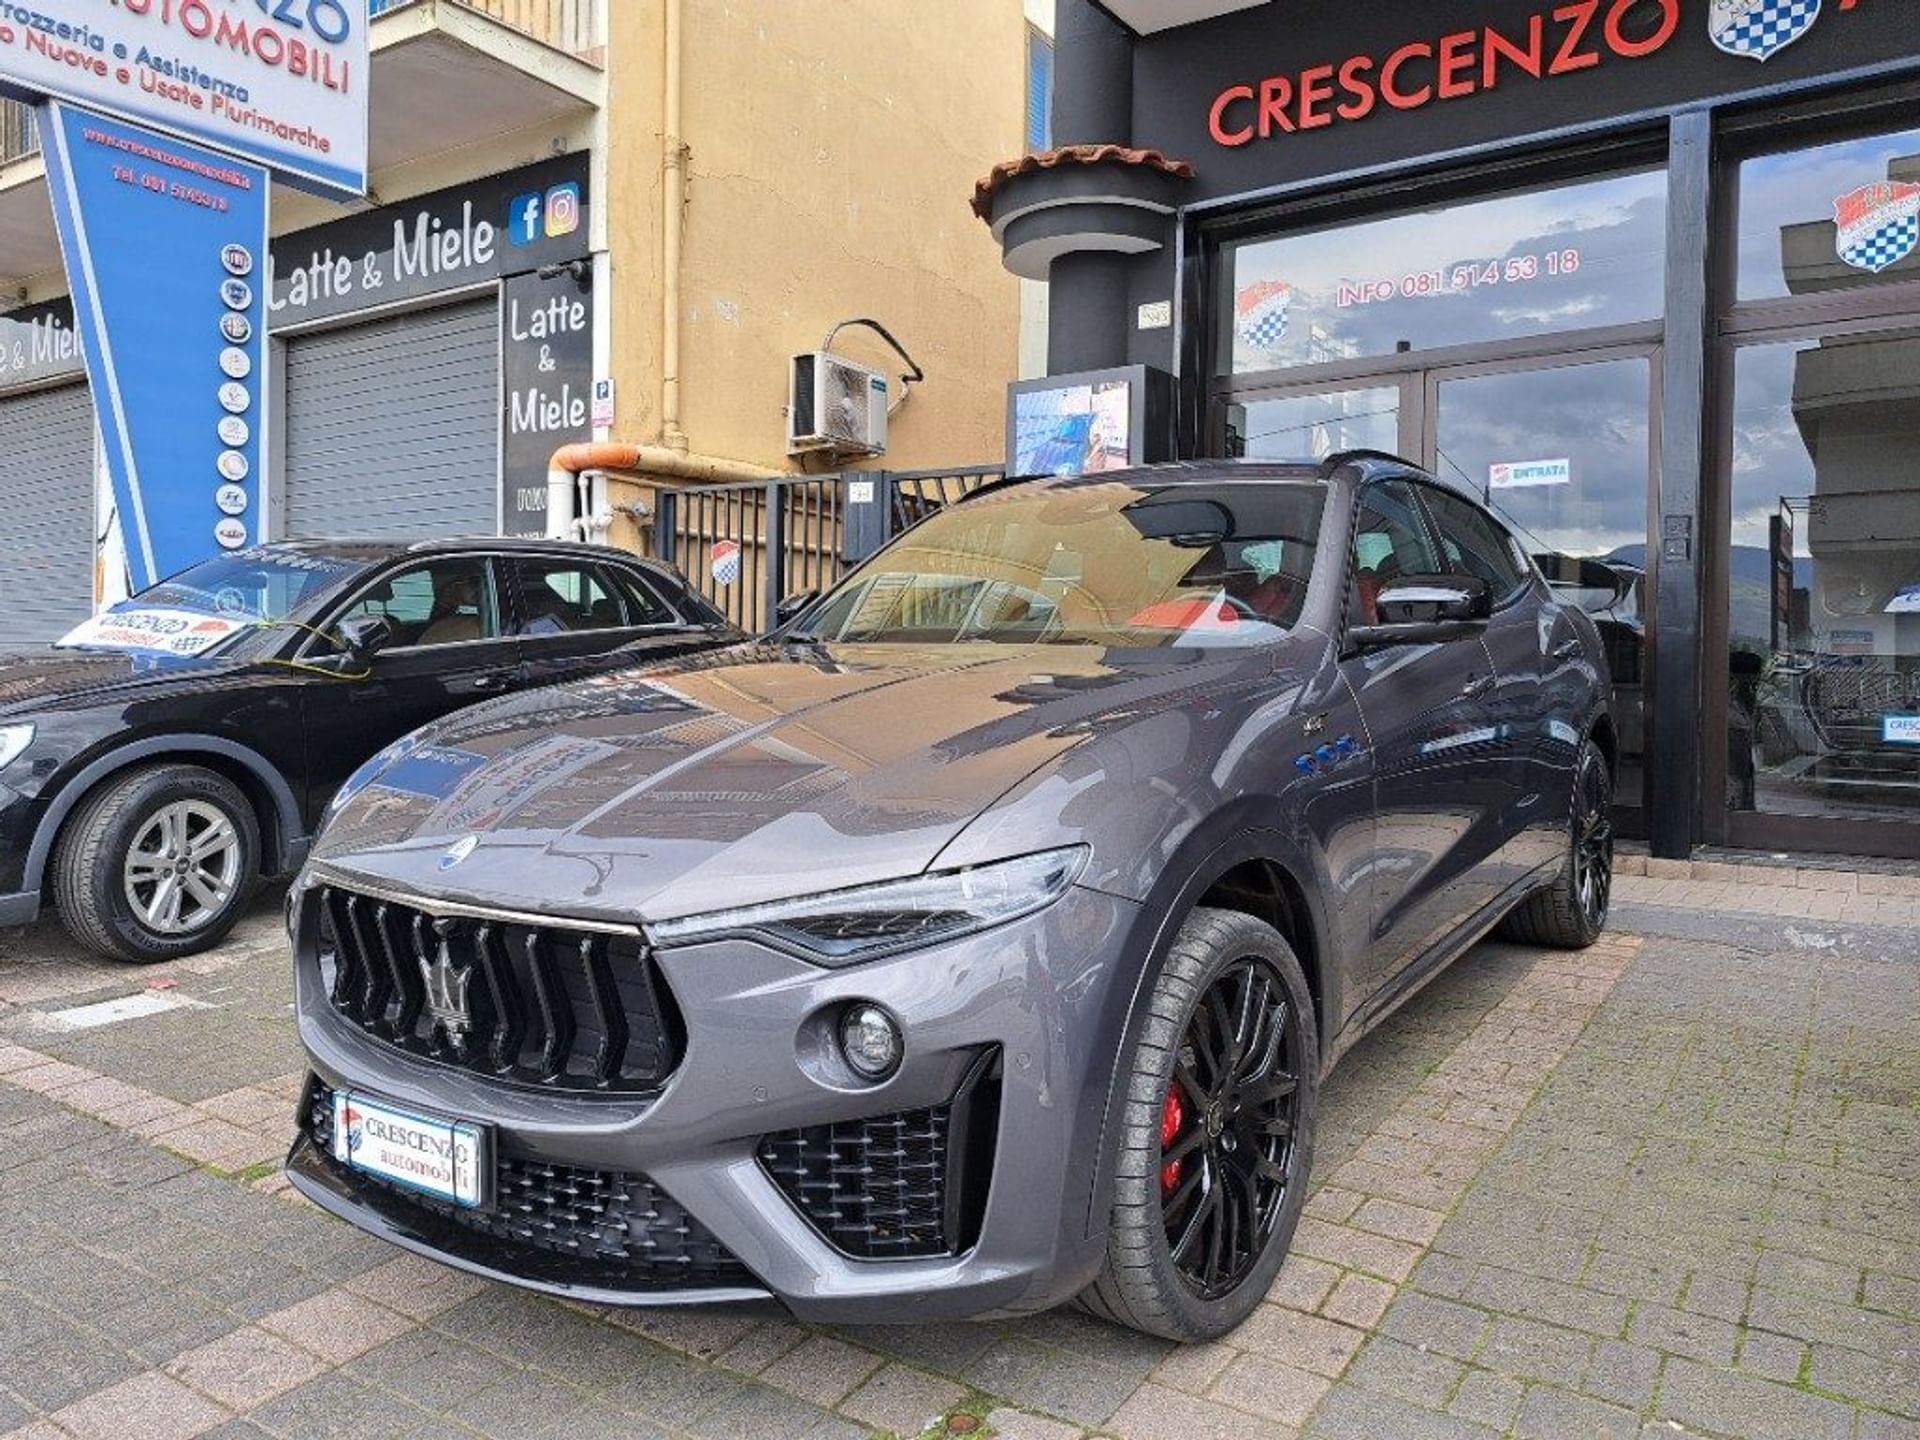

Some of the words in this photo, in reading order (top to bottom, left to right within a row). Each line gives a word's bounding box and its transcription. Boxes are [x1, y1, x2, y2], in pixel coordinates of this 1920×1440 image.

[0, 2, 105, 52] rozzeria
[113, 43, 127, 60] e
[135, 46, 250, 103] Assistenza
[1208, 0, 1680, 147] CRESCENZO
[26, 27, 108, 77] Nuove
[116, 67, 131, 85] e
[140, 68, 203, 110] Usate
[210, 94, 332, 154] Plurimarche
[266, 247, 352, 312] Latte
[362, 251, 384, 290] &
[393, 200, 495, 282] Miele
[1337, 280, 1395, 308] INFO
[1400, 271, 1443, 298] 081
[1451, 260, 1498, 289] 514
[1504, 256, 1536, 281] 53
[1545, 249, 1579, 275] 18
[13, 340, 26, 371] &
[31, 312, 79, 366] Miel
[511, 295, 586, 342] Latte
[538, 344, 556, 372] &
[511, 383, 586, 434] Miele
[1513, 465, 1567, 479] ENTRATA
[366, 1117, 468, 1164] CRESCENZO
[381, 1148, 469, 1189] automobli
